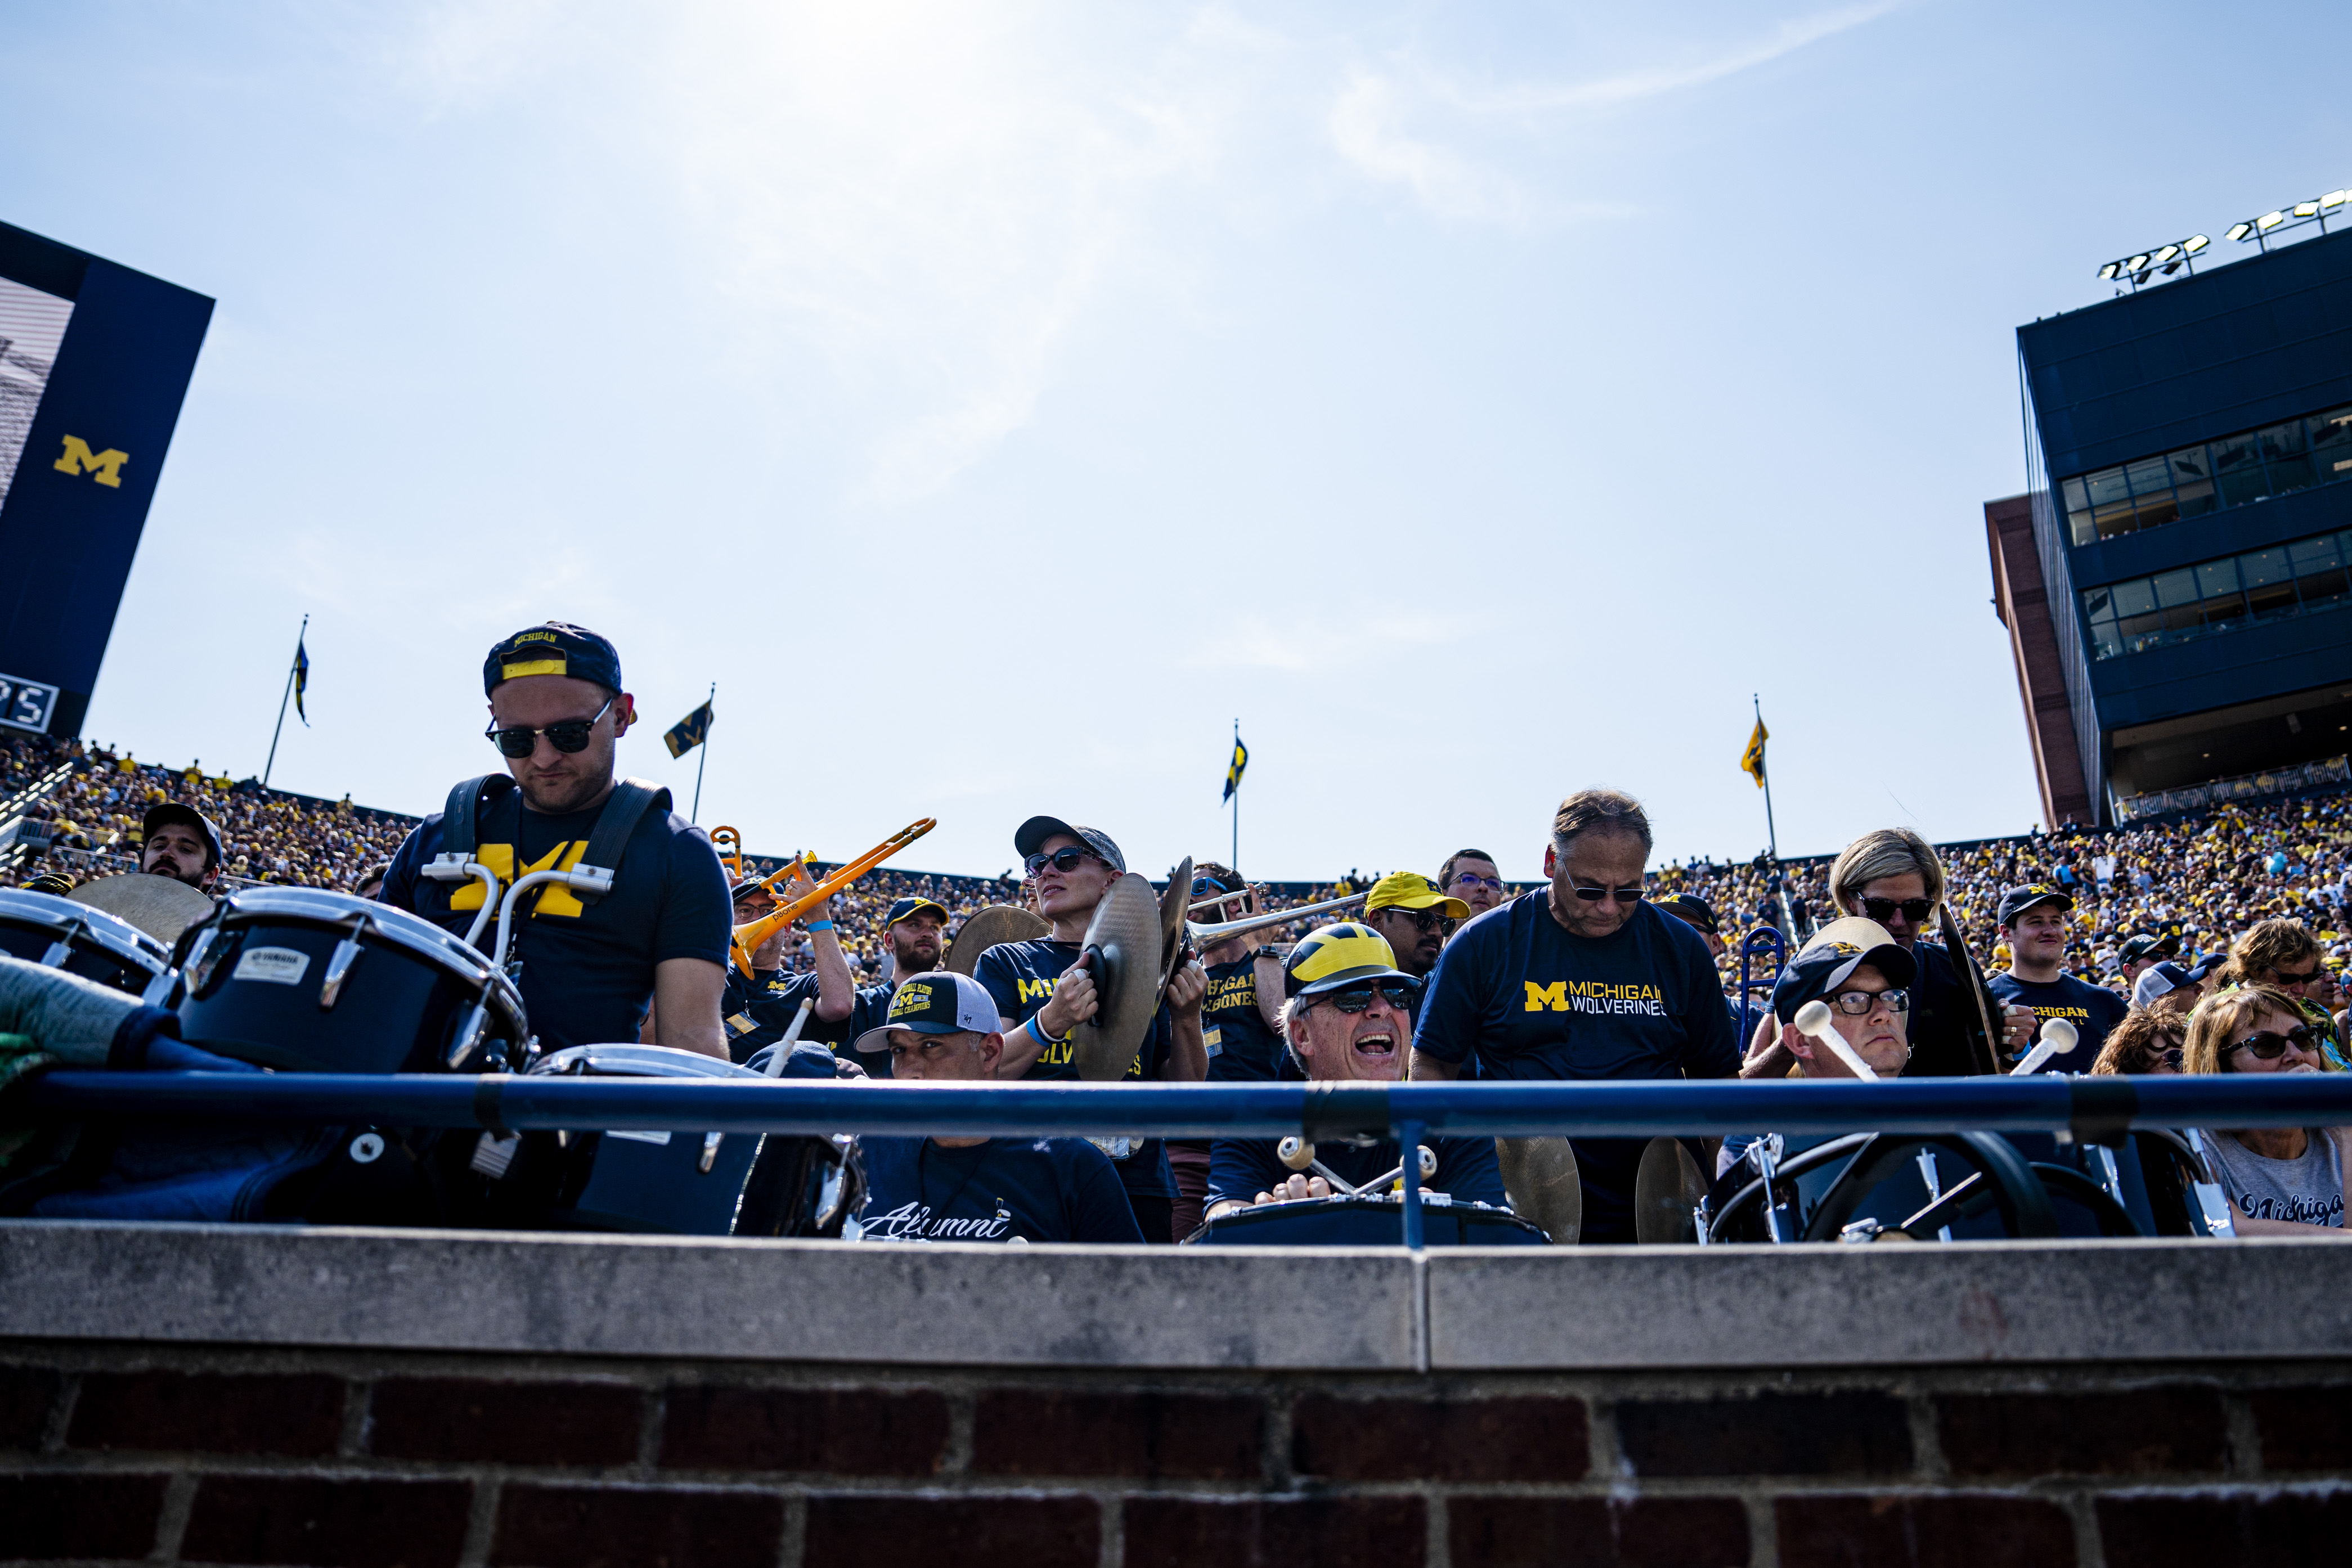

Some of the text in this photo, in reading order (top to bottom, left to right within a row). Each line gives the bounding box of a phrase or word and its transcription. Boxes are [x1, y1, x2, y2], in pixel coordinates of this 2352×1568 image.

[53, 434, 129, 488] M
[514, 632, 557, 648] MICHIGAN
[2027, 885, 2049, 895] M
[773, 903, 798, 922] pBone
[1828, 942, 1865, 954] M
[767, 981, 786, 990] M
[899, 992, 914, 1008] M
[1524, 981, 1569, 1012] M
[904, 1000, 931, 1014] CHAMPIONS
[2239, 1193, 2344, 1228] Michiga
[860, 1201, 1008, 1238] Alumni
